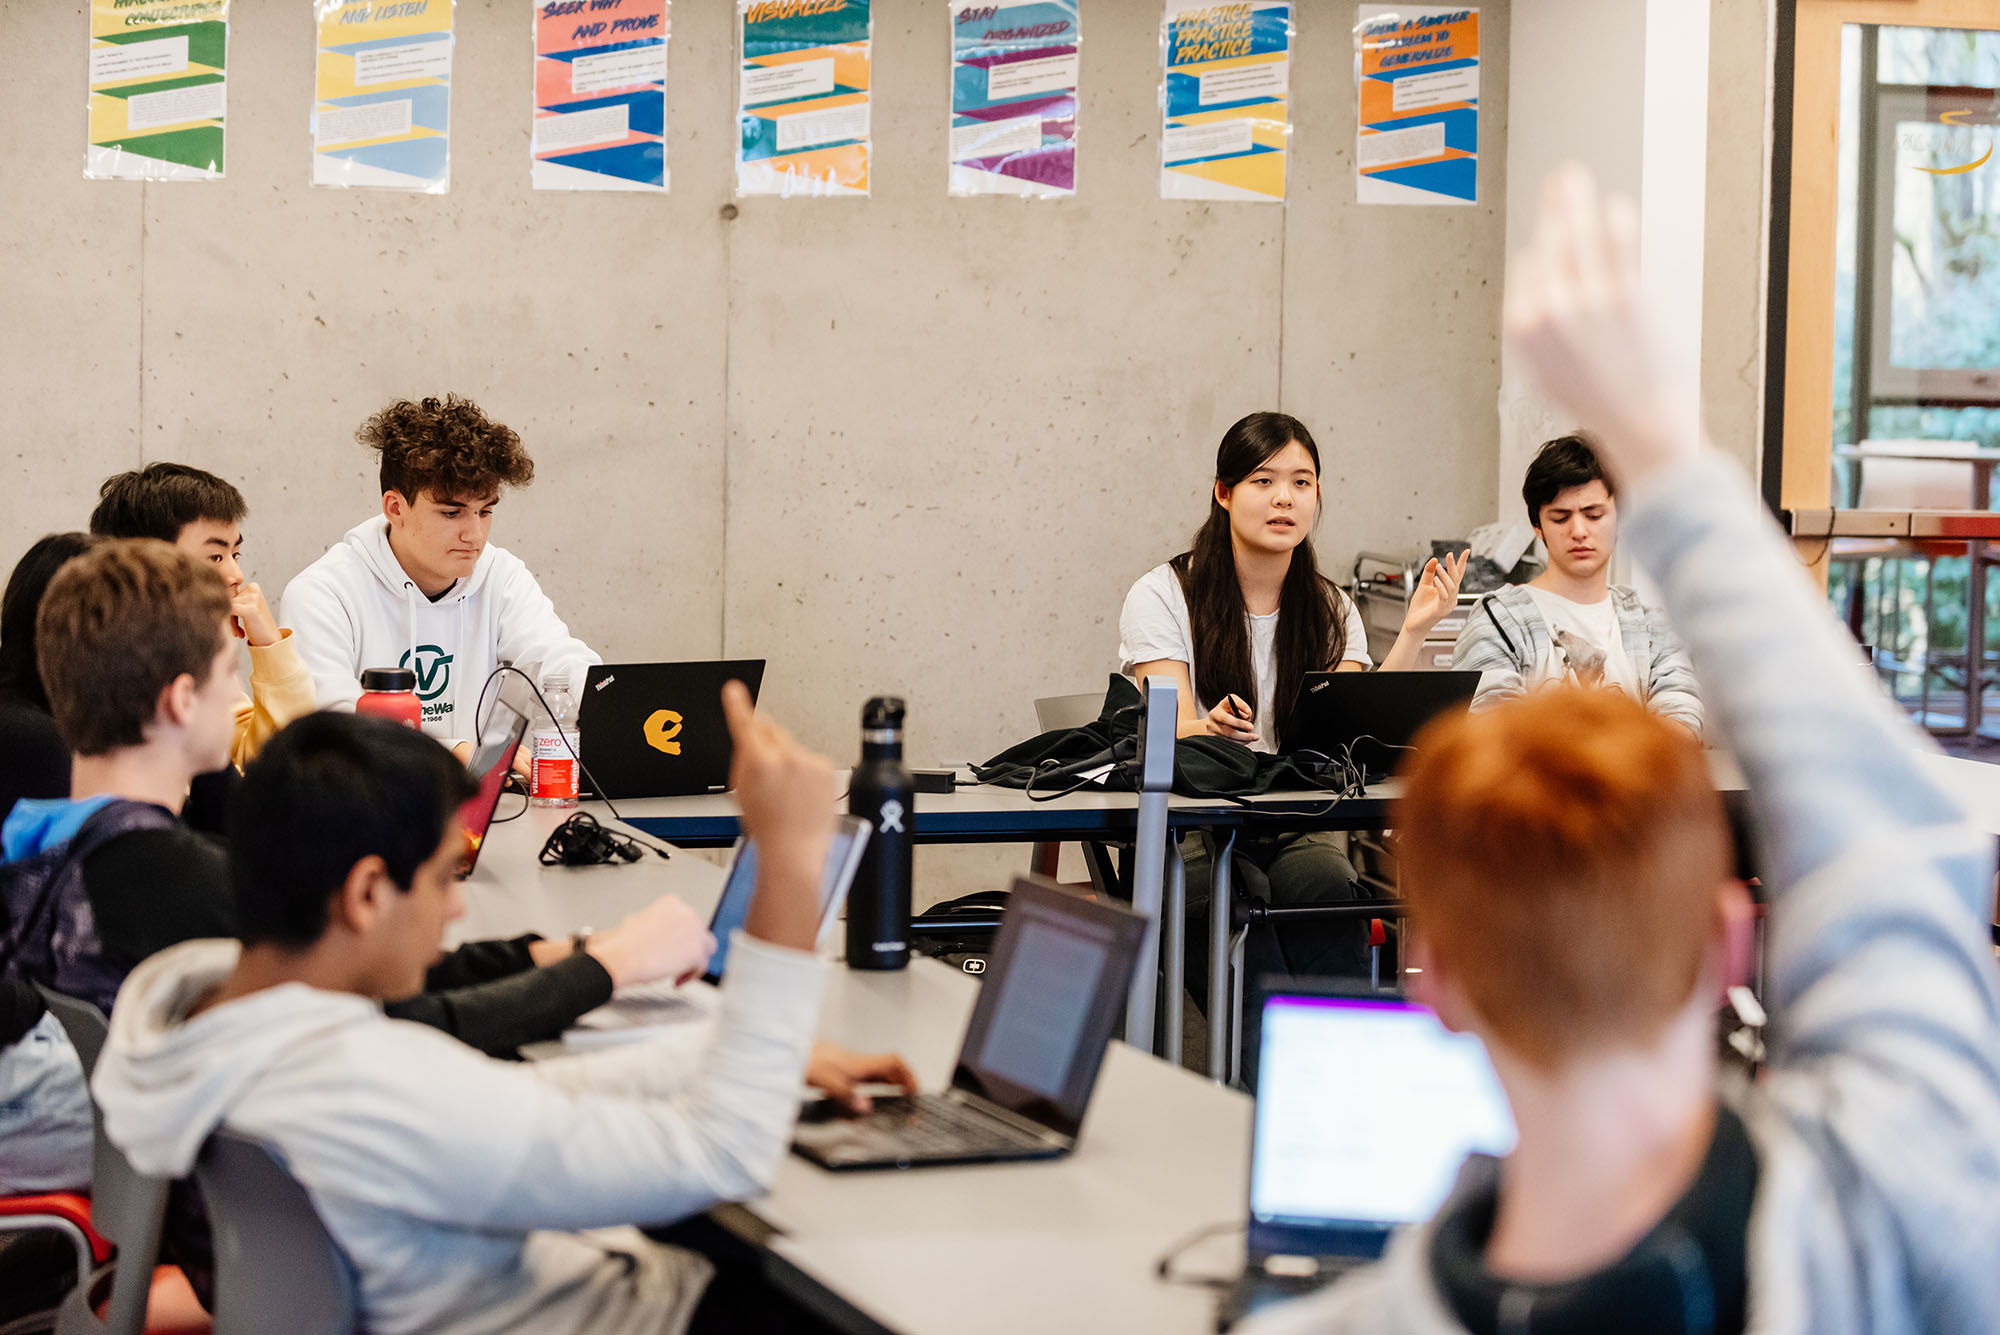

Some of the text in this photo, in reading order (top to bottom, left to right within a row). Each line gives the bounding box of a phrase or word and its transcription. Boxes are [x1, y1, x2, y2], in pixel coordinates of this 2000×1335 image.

[338, 0, 428, 25] AND LISTEN
[543, 0, 587, 19] SEEK
[747, 0, 848, 24] VISUALIZE
[958, 5, 999, 24] STAY
[1175, 2, 1254, 28] PRACTICE
[572, 13, 660, 40] AND PROVE
[981, 20, 1071, 46] ORGANIZED
[1175, 20, 1254, 46] PRACTICE
[1403, 19, 1413, 31] A
[1436, 30, 1450, 42] TO
[1174, 38, 1254, 64] PRACTICE
[1379, 46, 1454, 67] GENERALIZE
[539, 737, 562, 747] zero
